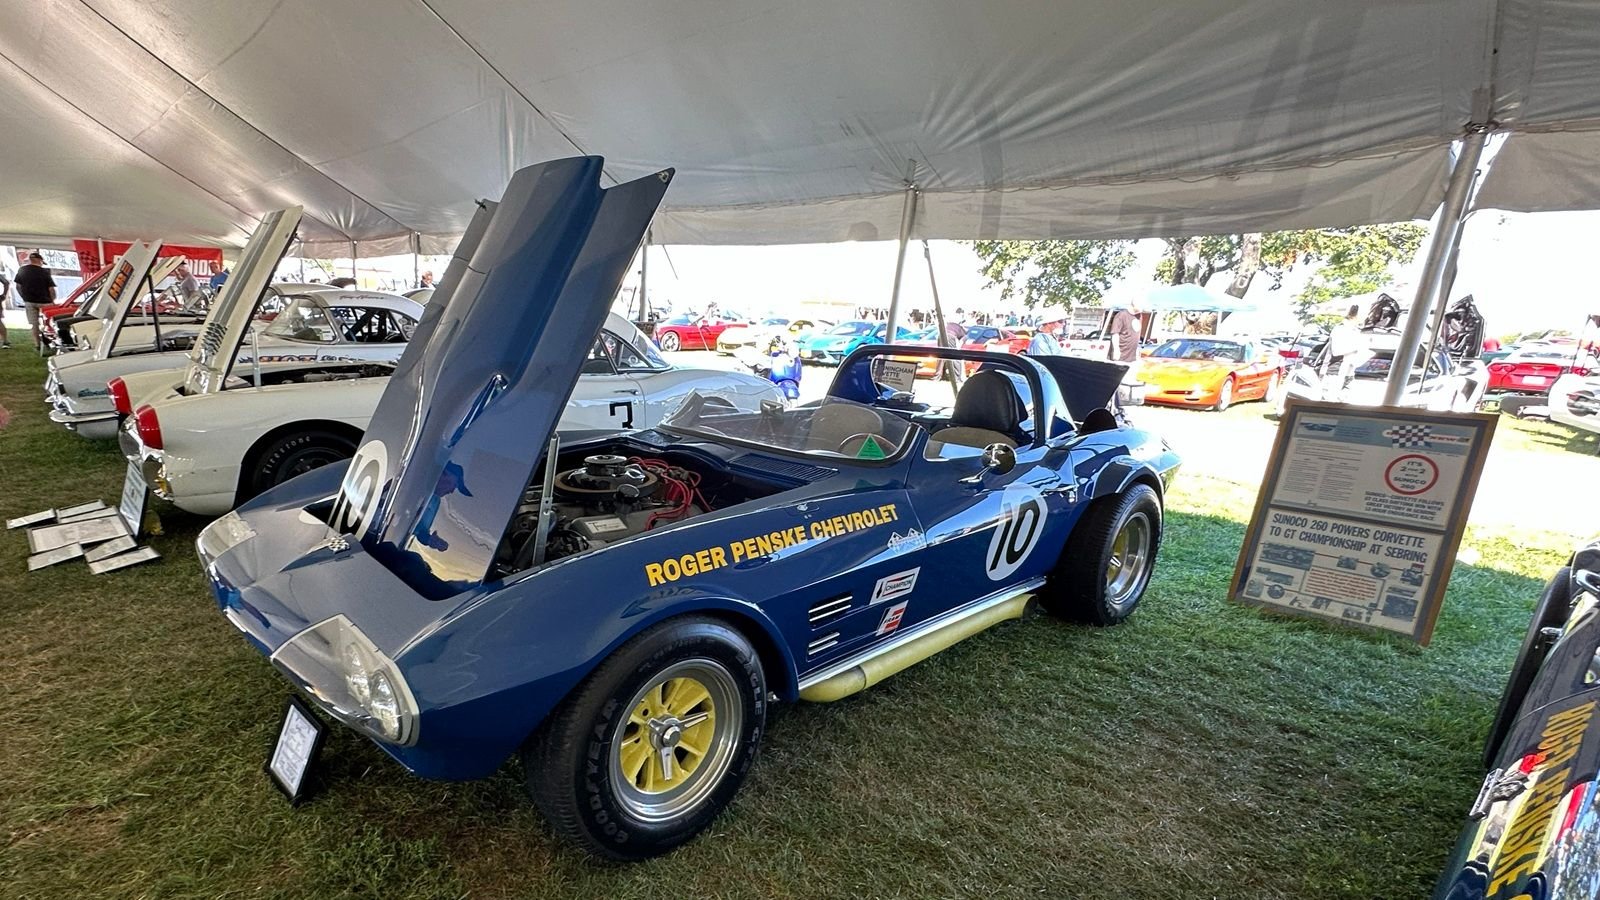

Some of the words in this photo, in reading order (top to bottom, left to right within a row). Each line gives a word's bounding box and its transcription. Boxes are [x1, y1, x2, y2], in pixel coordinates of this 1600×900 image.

[1393, 476, 1427, 485] SUNOCO
[645, 546, 728, 587] ROGER
[729, 526, 808, 563] PENSKE
[810, 503, 899, 541] CHEVROLET
[989, 495, 1041, 572] 10
[1269, 525, 1281, 537] TO
[1284, 527, 1297, 540] GT
[1298, 530, 1367, 552] CHAMPIONSHIP
[1369, 544, 1383, 556] AT
[1384, 546, 1428, 563] SEBRING
[1273, 513, 1308, 528] SUNOCO
[1310, 519, 1329, 532] 260
[1330, 522, 1370, 540] POWERS
[1373, 529, 1425, 549] CORVETTE
[885, 580, 912, 592] CHAMPION
[586, 698, 629, 844] GOODYEAR
[1486, 767, 1572, 898] PENSKE
